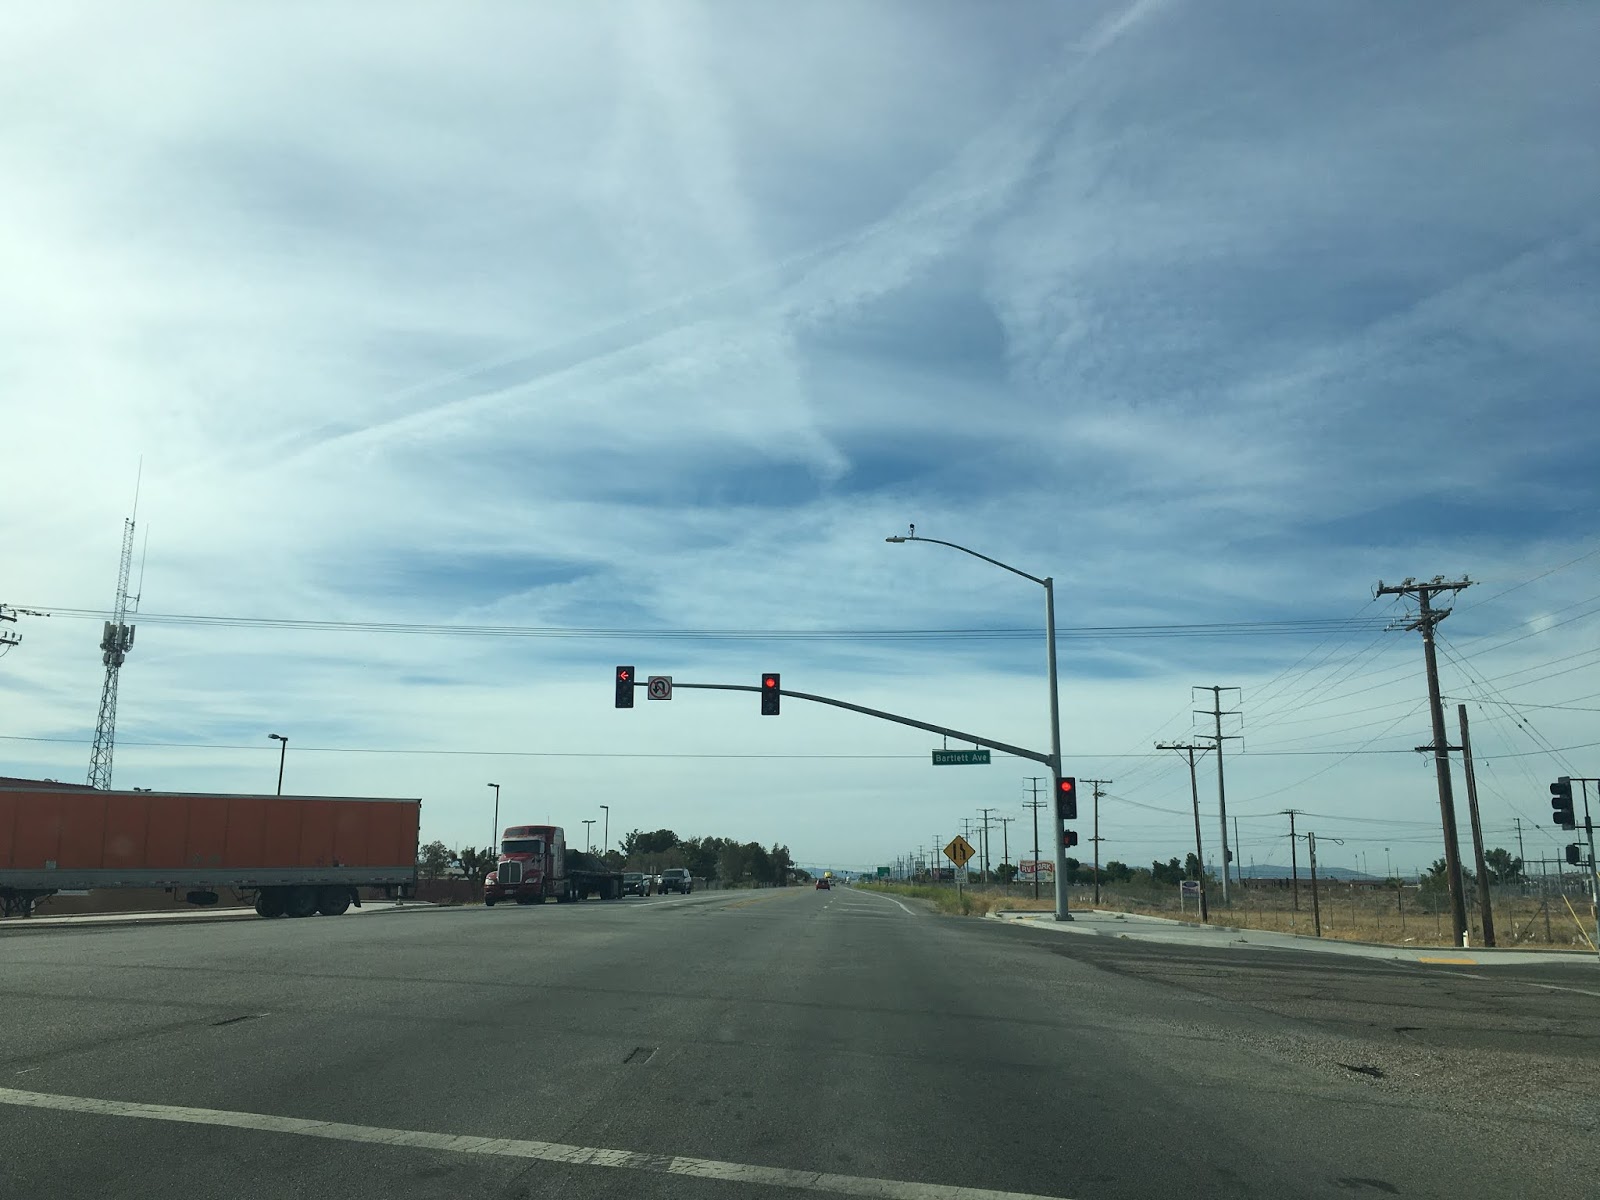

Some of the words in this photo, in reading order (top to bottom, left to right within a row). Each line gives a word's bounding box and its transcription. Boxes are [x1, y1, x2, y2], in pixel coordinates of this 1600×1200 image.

[935, 754, 969, 762] Bartlett
[971, 753, 987, 761] Ave
[1021, 865, 1032, 873] RV
